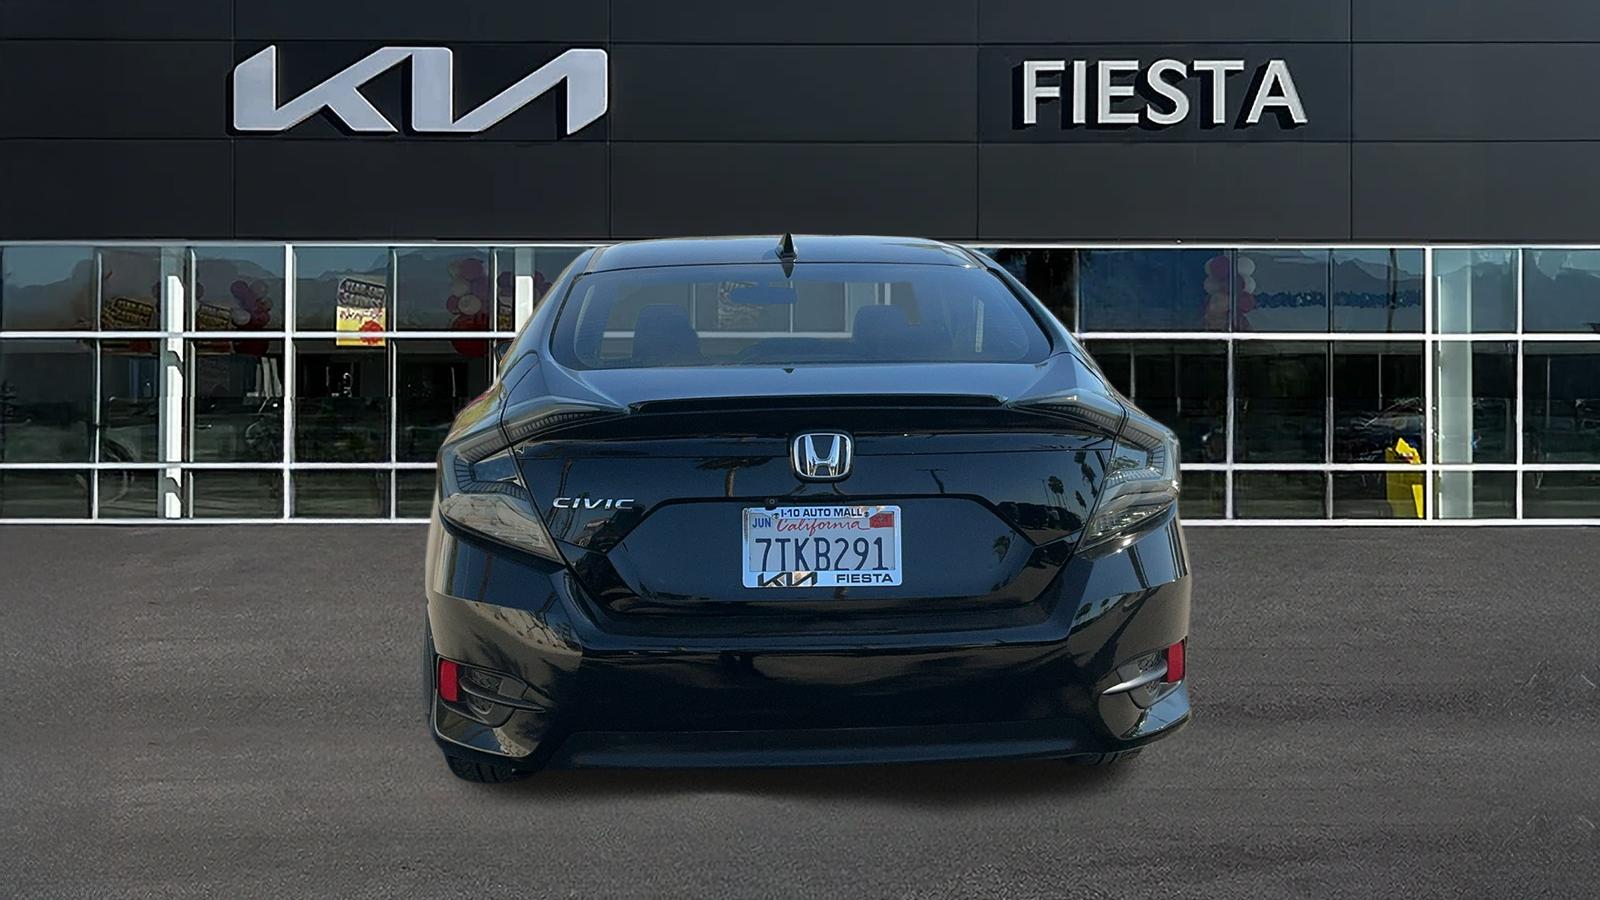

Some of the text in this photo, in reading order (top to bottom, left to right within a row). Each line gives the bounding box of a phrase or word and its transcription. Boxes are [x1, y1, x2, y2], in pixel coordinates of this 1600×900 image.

[233, 44, 608, 135] KIA
[1023, 59, 1308, 125] FIESTA
[552, 497, 634, 510] CIVIC
[781, 508, 863, 517] I-10 AUTO MALL
[752, 518, 772, 528] JUN
[776, 518, 871, 536] California
[755, 537, 889, 572] 7TKB291
[836, 573, 894, 583] FIESTA
